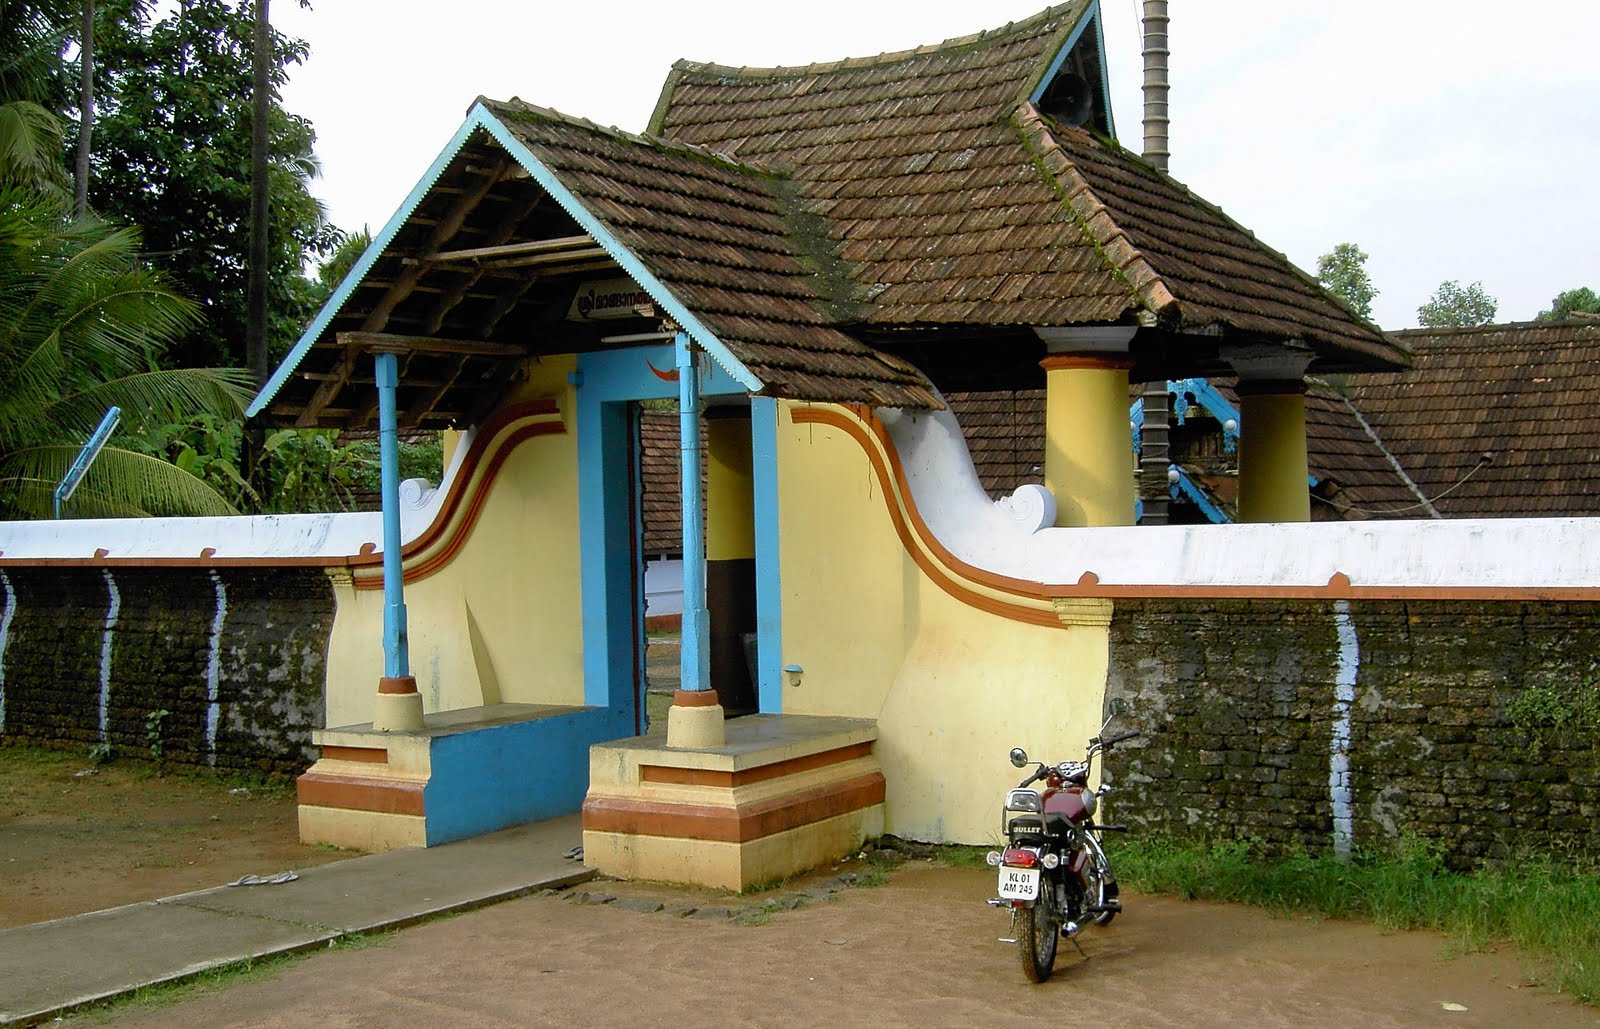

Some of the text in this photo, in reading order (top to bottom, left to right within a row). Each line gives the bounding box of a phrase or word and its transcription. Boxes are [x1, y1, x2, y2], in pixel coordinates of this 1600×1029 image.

[1009, 873, 1030, 883] KL 01
[1003, 883, 1033, 895] AM 245
